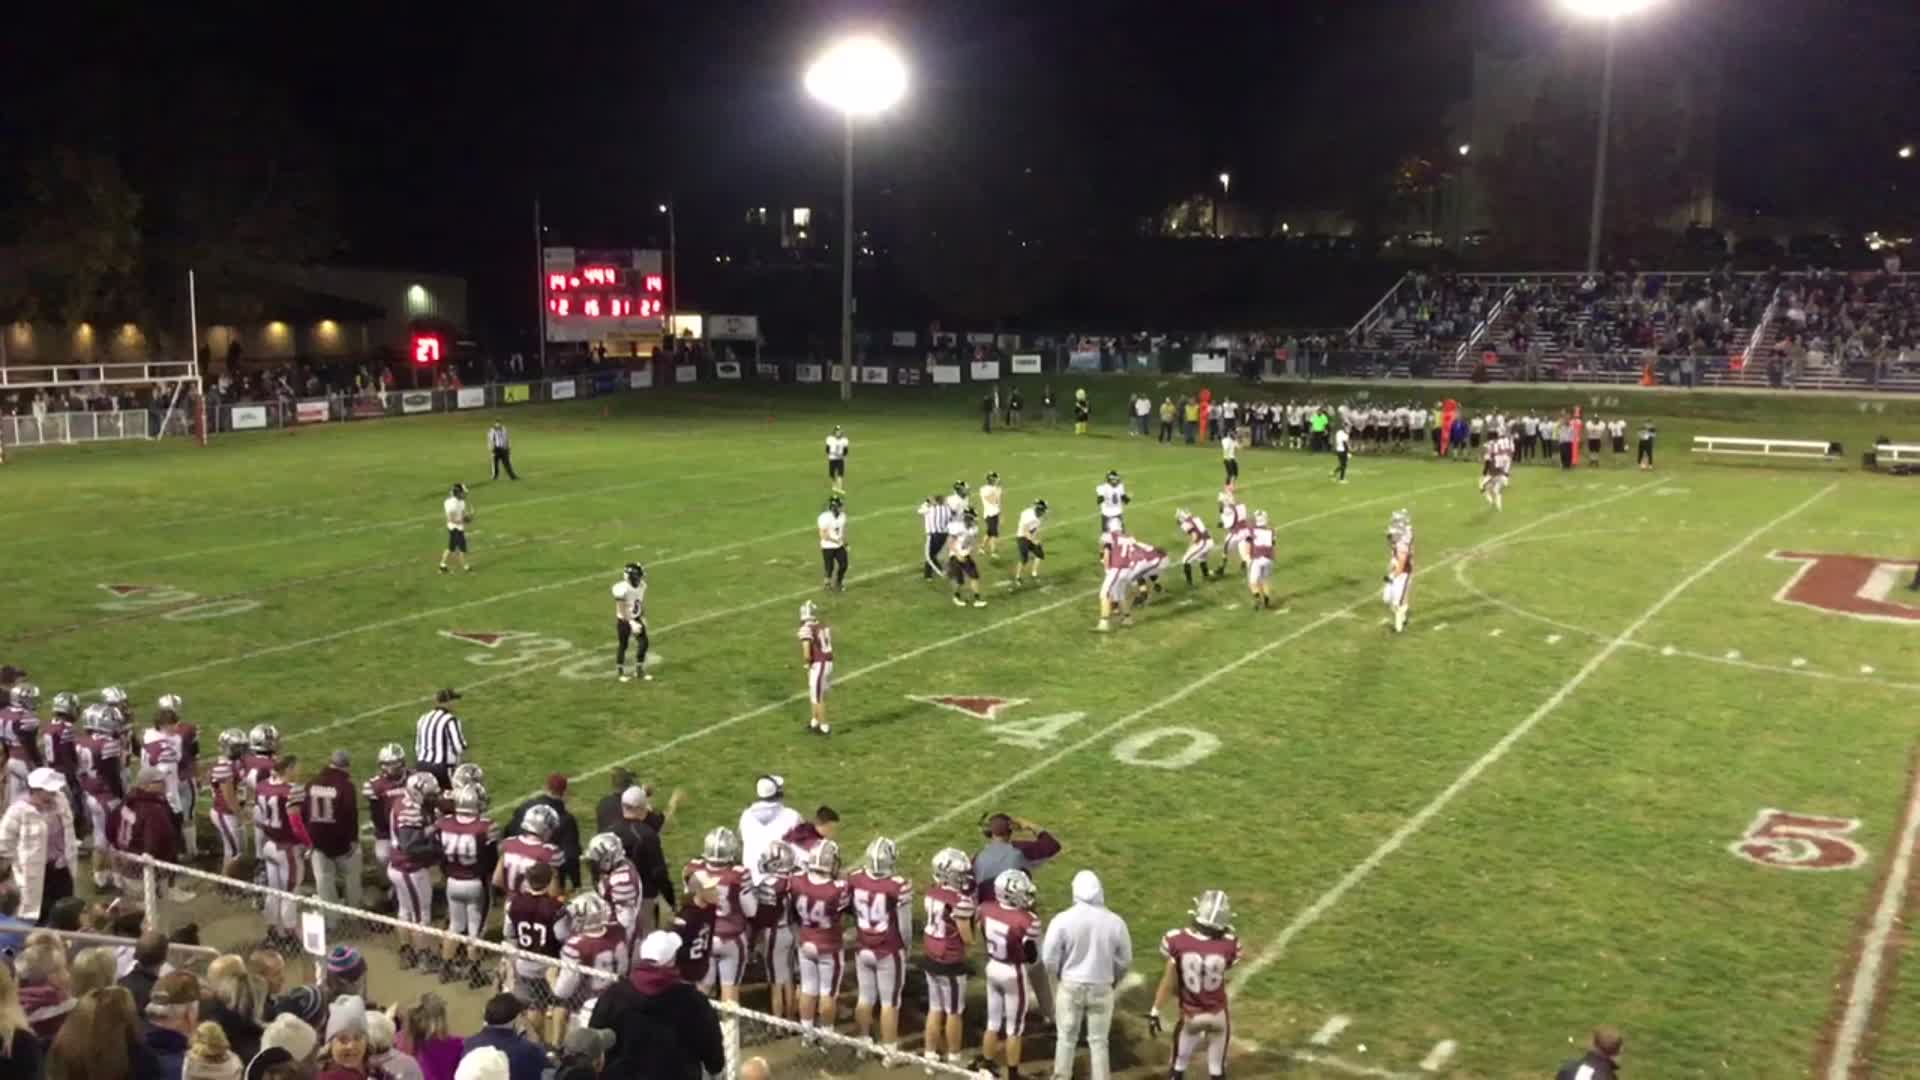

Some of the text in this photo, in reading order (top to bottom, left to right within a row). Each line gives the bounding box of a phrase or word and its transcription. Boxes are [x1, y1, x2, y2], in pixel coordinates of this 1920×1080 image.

[416, 338, 438, 361] 27
[1729, 807, 1870, 870] 5
[853, 888, 889, 933] 54
[517, 920, 547, 947] 67
[984, 917, 1010, 960] 5
[1181, 952, 1227, 994] 88
